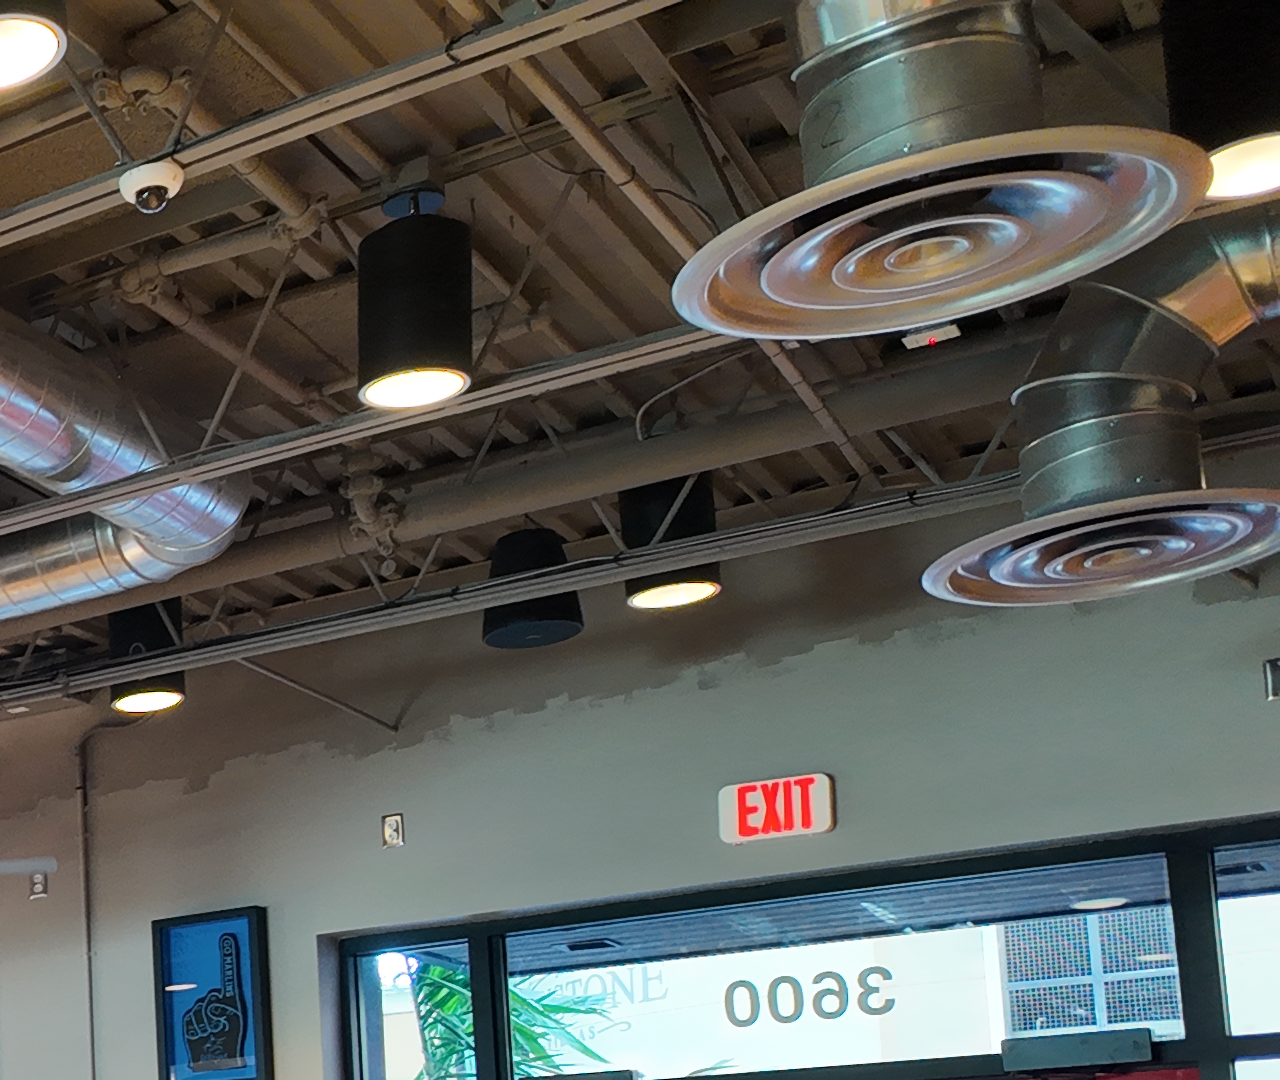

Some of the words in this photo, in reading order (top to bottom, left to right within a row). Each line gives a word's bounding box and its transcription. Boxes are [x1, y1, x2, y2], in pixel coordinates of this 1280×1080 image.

[737, 777, 816, 838] EXIT
[223, 937, 232, 953] GO
[224, 954, 235, 998] MARLINS
